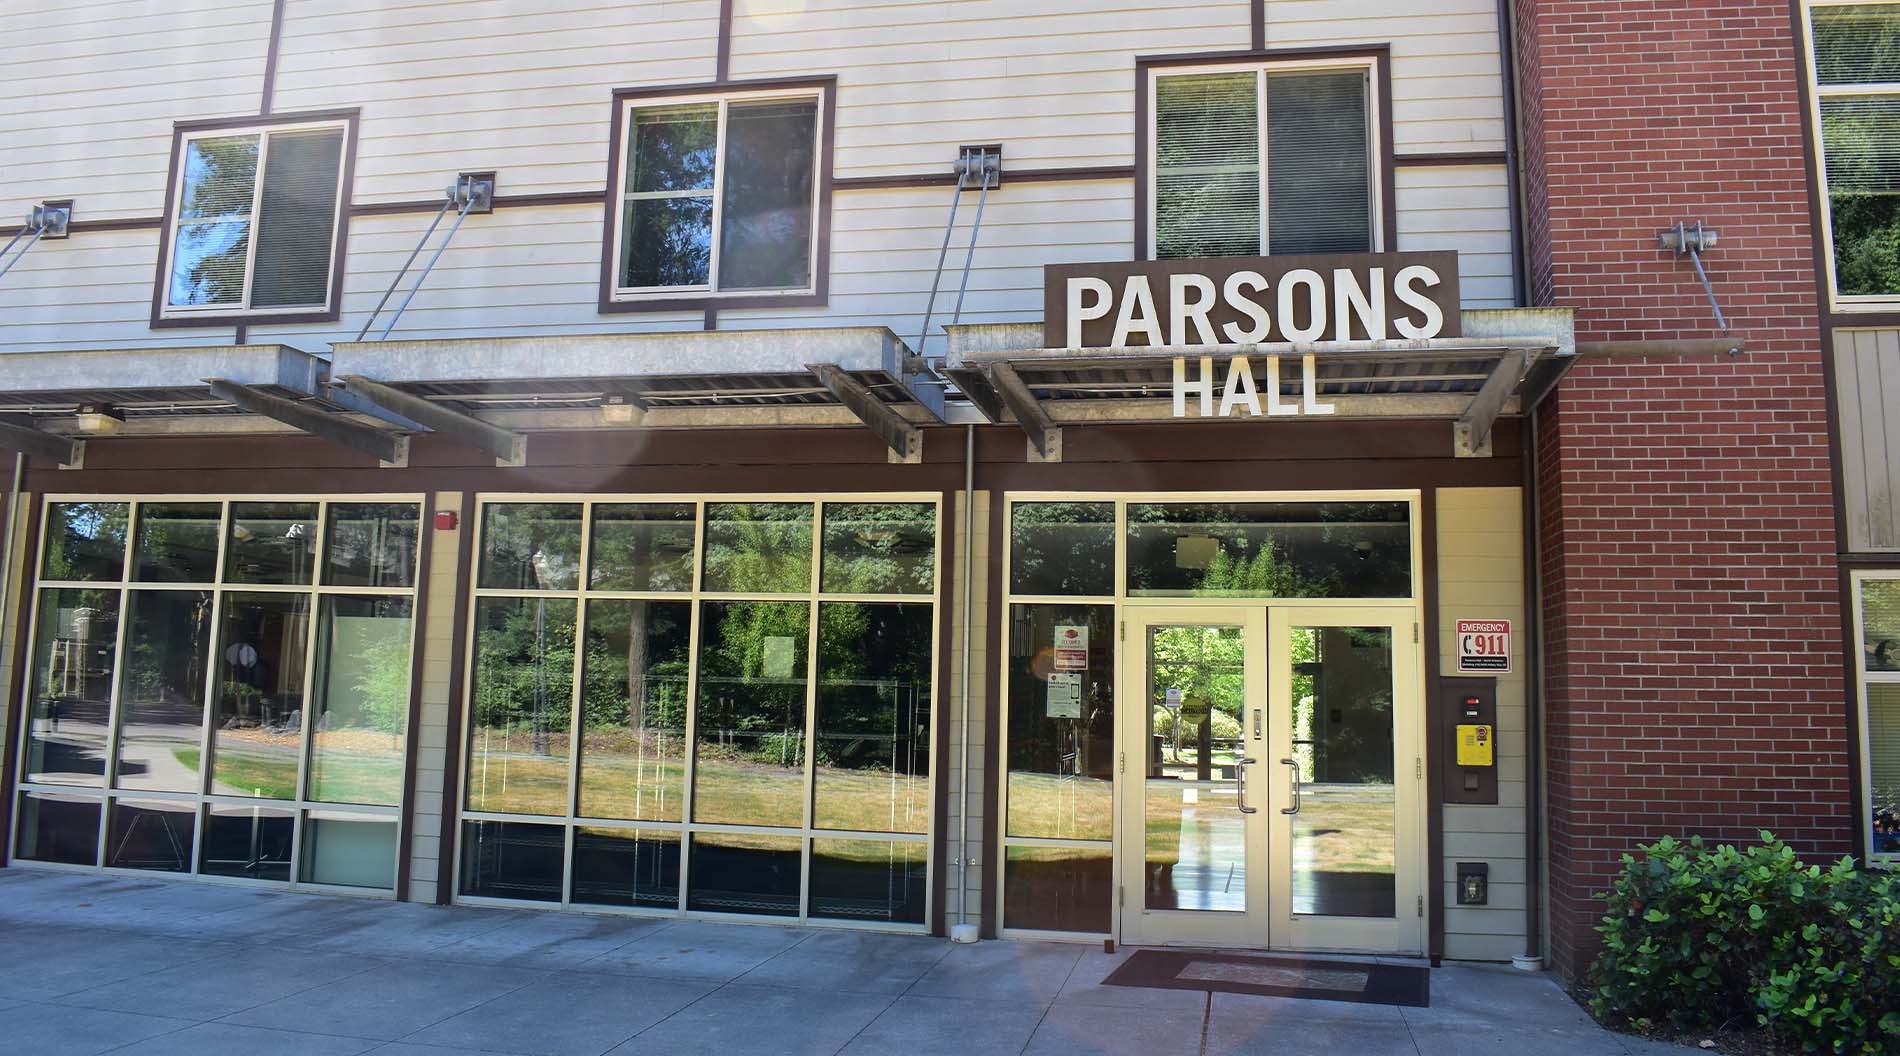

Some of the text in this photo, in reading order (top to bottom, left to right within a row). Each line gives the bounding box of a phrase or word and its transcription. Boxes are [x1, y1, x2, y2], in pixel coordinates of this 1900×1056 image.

[1066, 265, 1444, 349] PARSONS
[1173, 354, 1335, 417] HALL
[1461, 623, 1505, 632] EMERGENCY
[1475, 634, 1505, 655] 911
